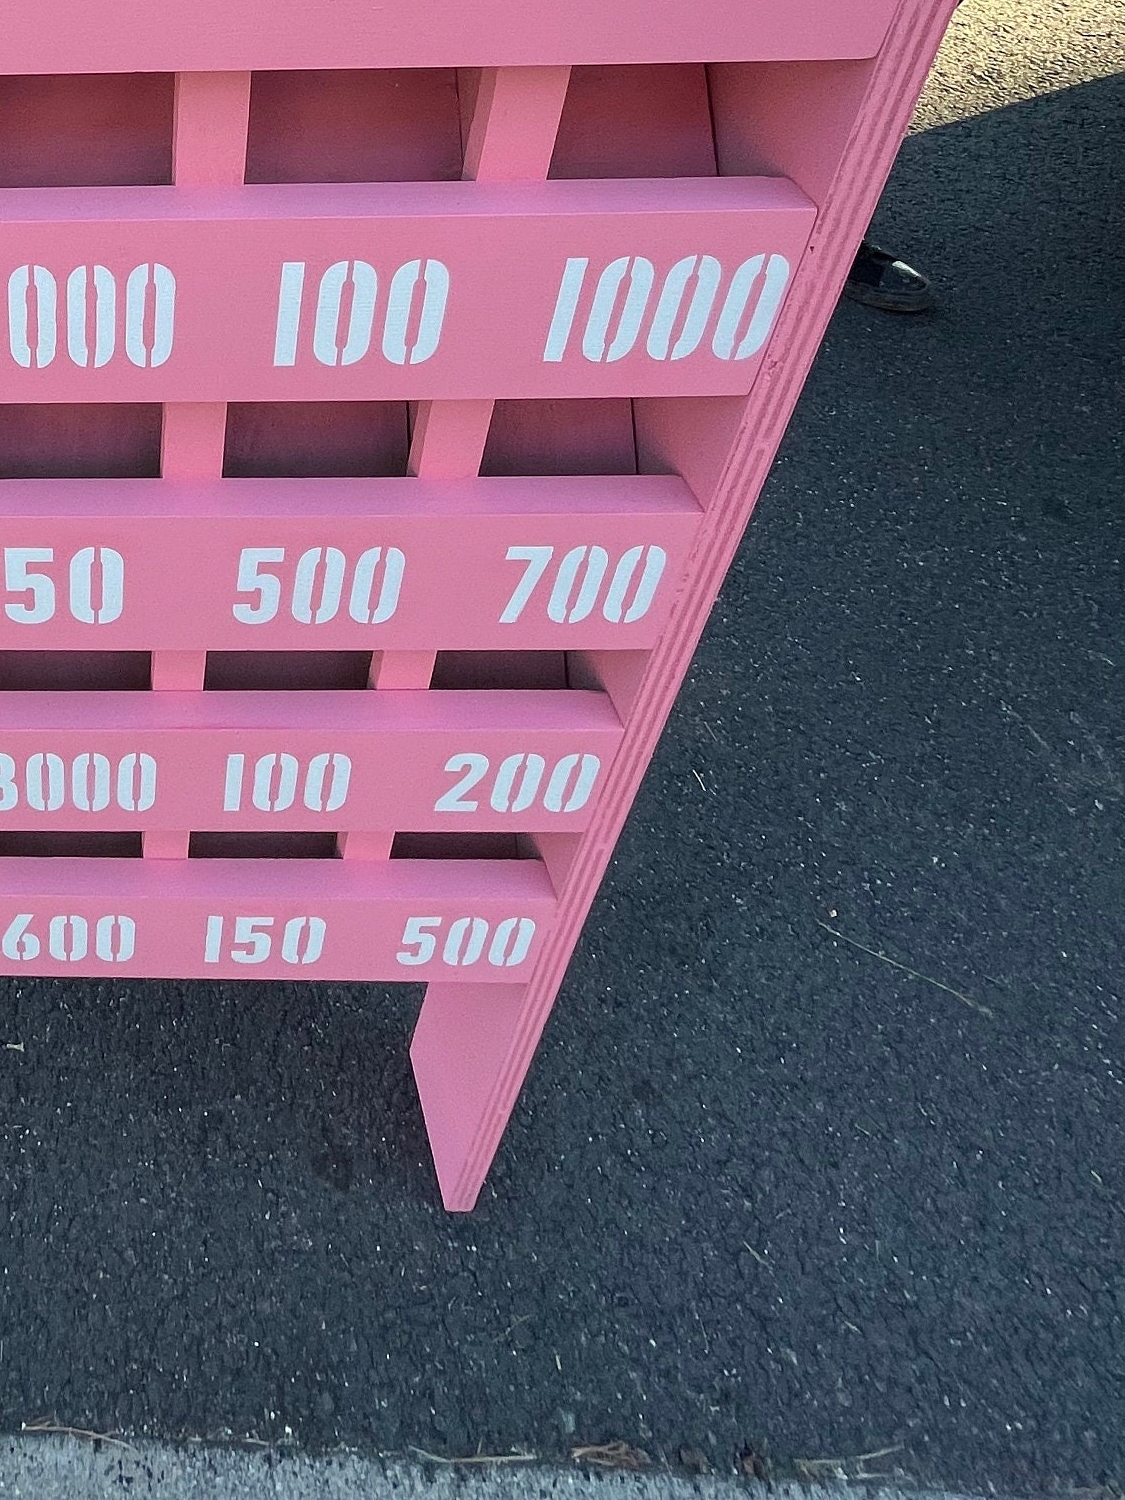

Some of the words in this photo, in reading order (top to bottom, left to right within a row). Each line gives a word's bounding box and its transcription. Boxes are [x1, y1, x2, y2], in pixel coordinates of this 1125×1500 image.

[273, 259, 451, 366] 100
[543, 253, 791, 363] 1000
[4, 547, 124, 625] 50
[232, 547, 406, 625] 500
[499, 545, 667, 624] 700
[223, 753, 352, 812] 100
[438, 753, 601, 813] 200
[1, 913, 136, 962] 600
[204, 915, 326, 964] 150
[396, 916, 536, 967] 500
